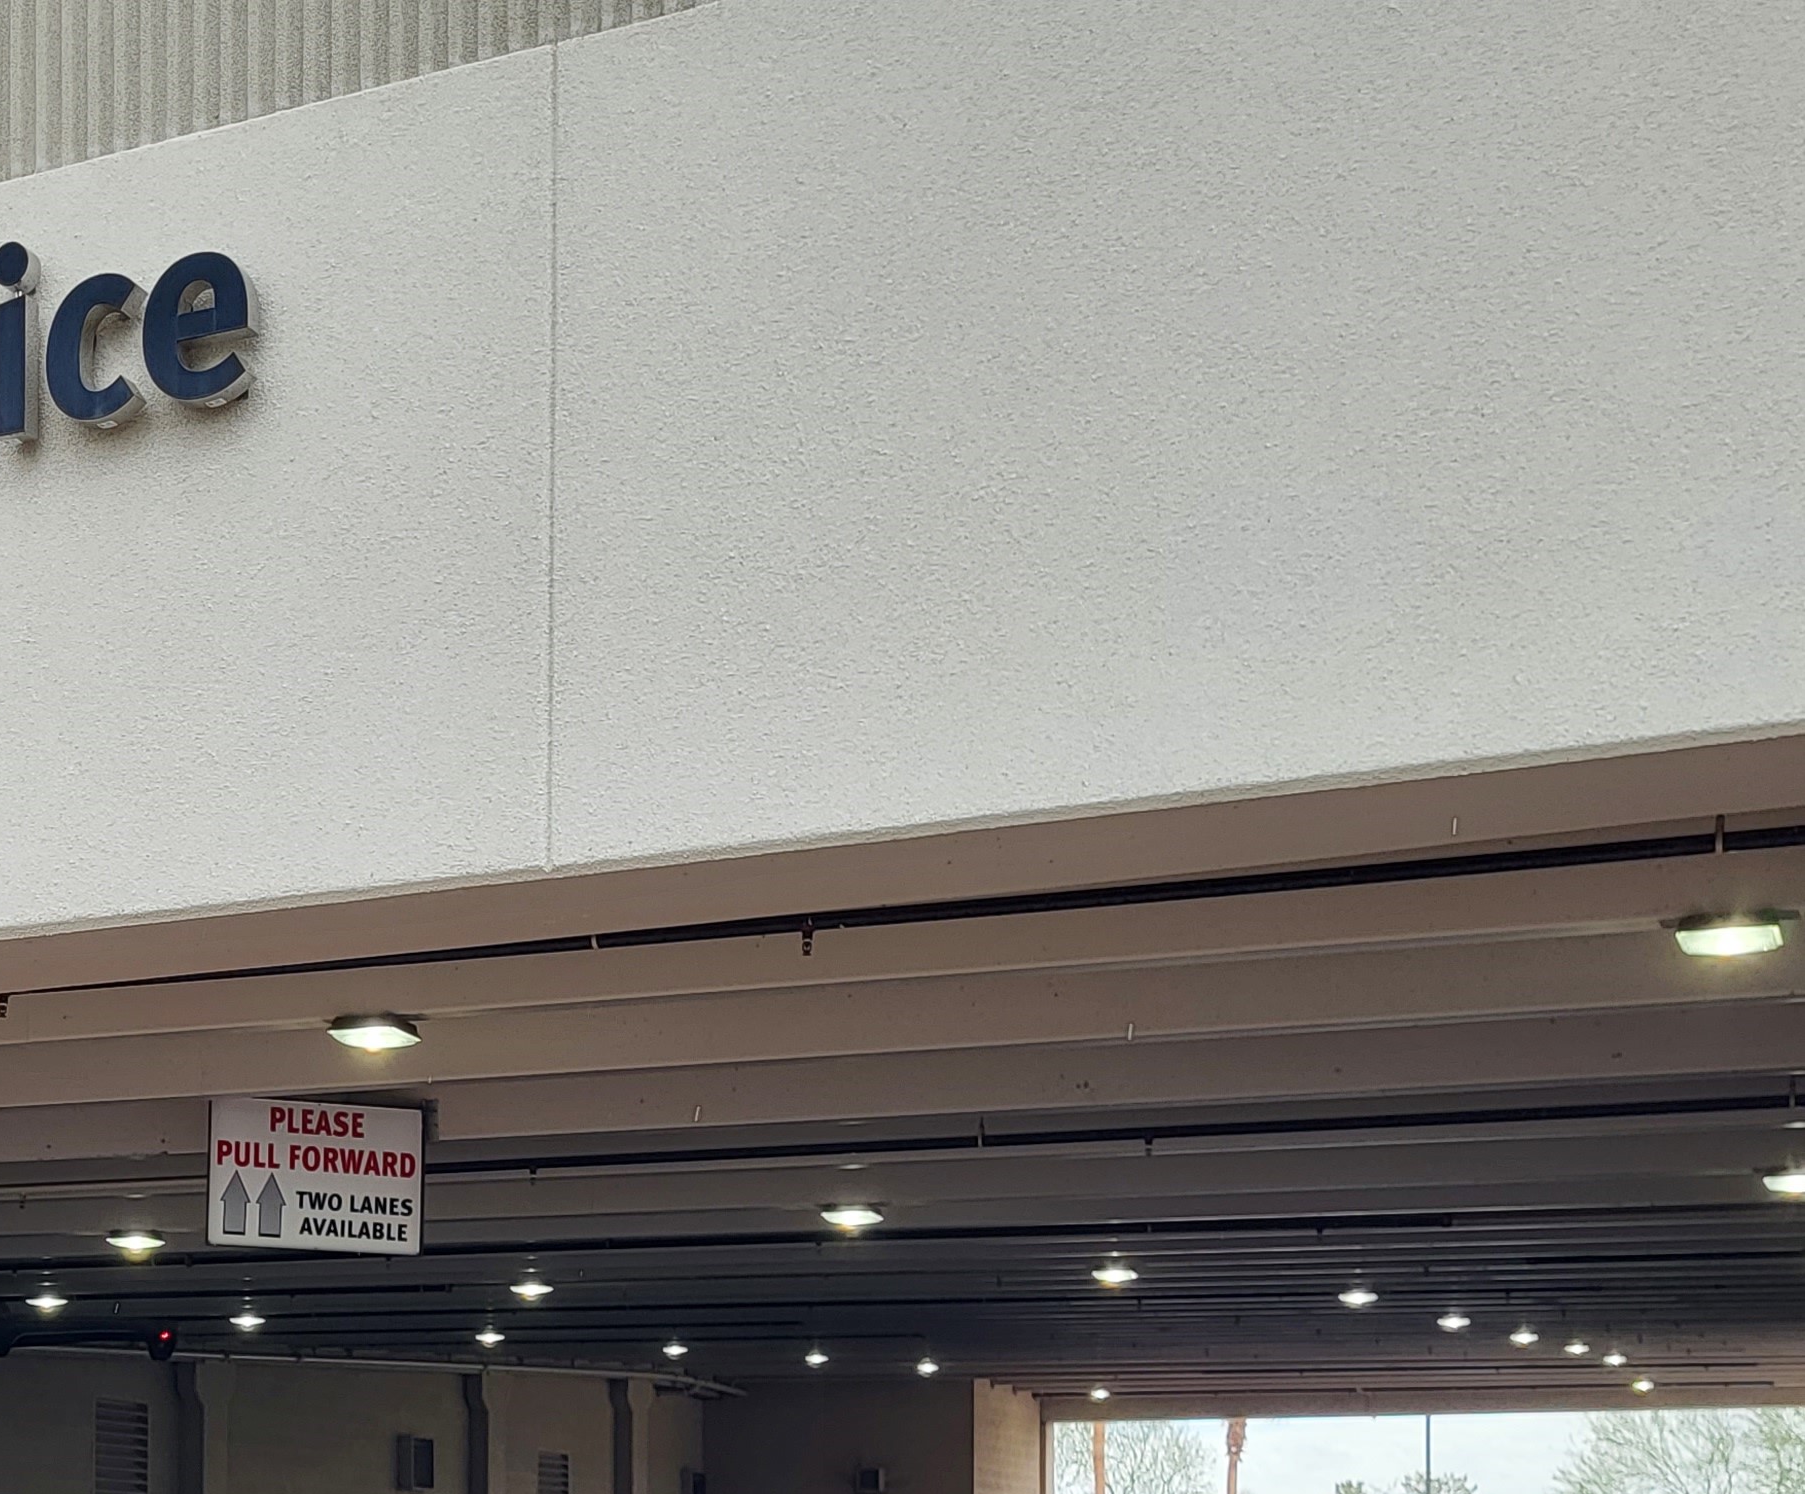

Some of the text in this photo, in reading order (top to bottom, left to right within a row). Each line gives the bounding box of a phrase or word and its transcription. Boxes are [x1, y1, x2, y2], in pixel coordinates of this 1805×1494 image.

[269, 1106, 365, 1138] PLEASE
[216, 1139, 416, 1178] PULL FORWARD
[295, 1190, 413, 1217] TWO LANES
[299, 1217, 408, 1242] AVAILABLE
